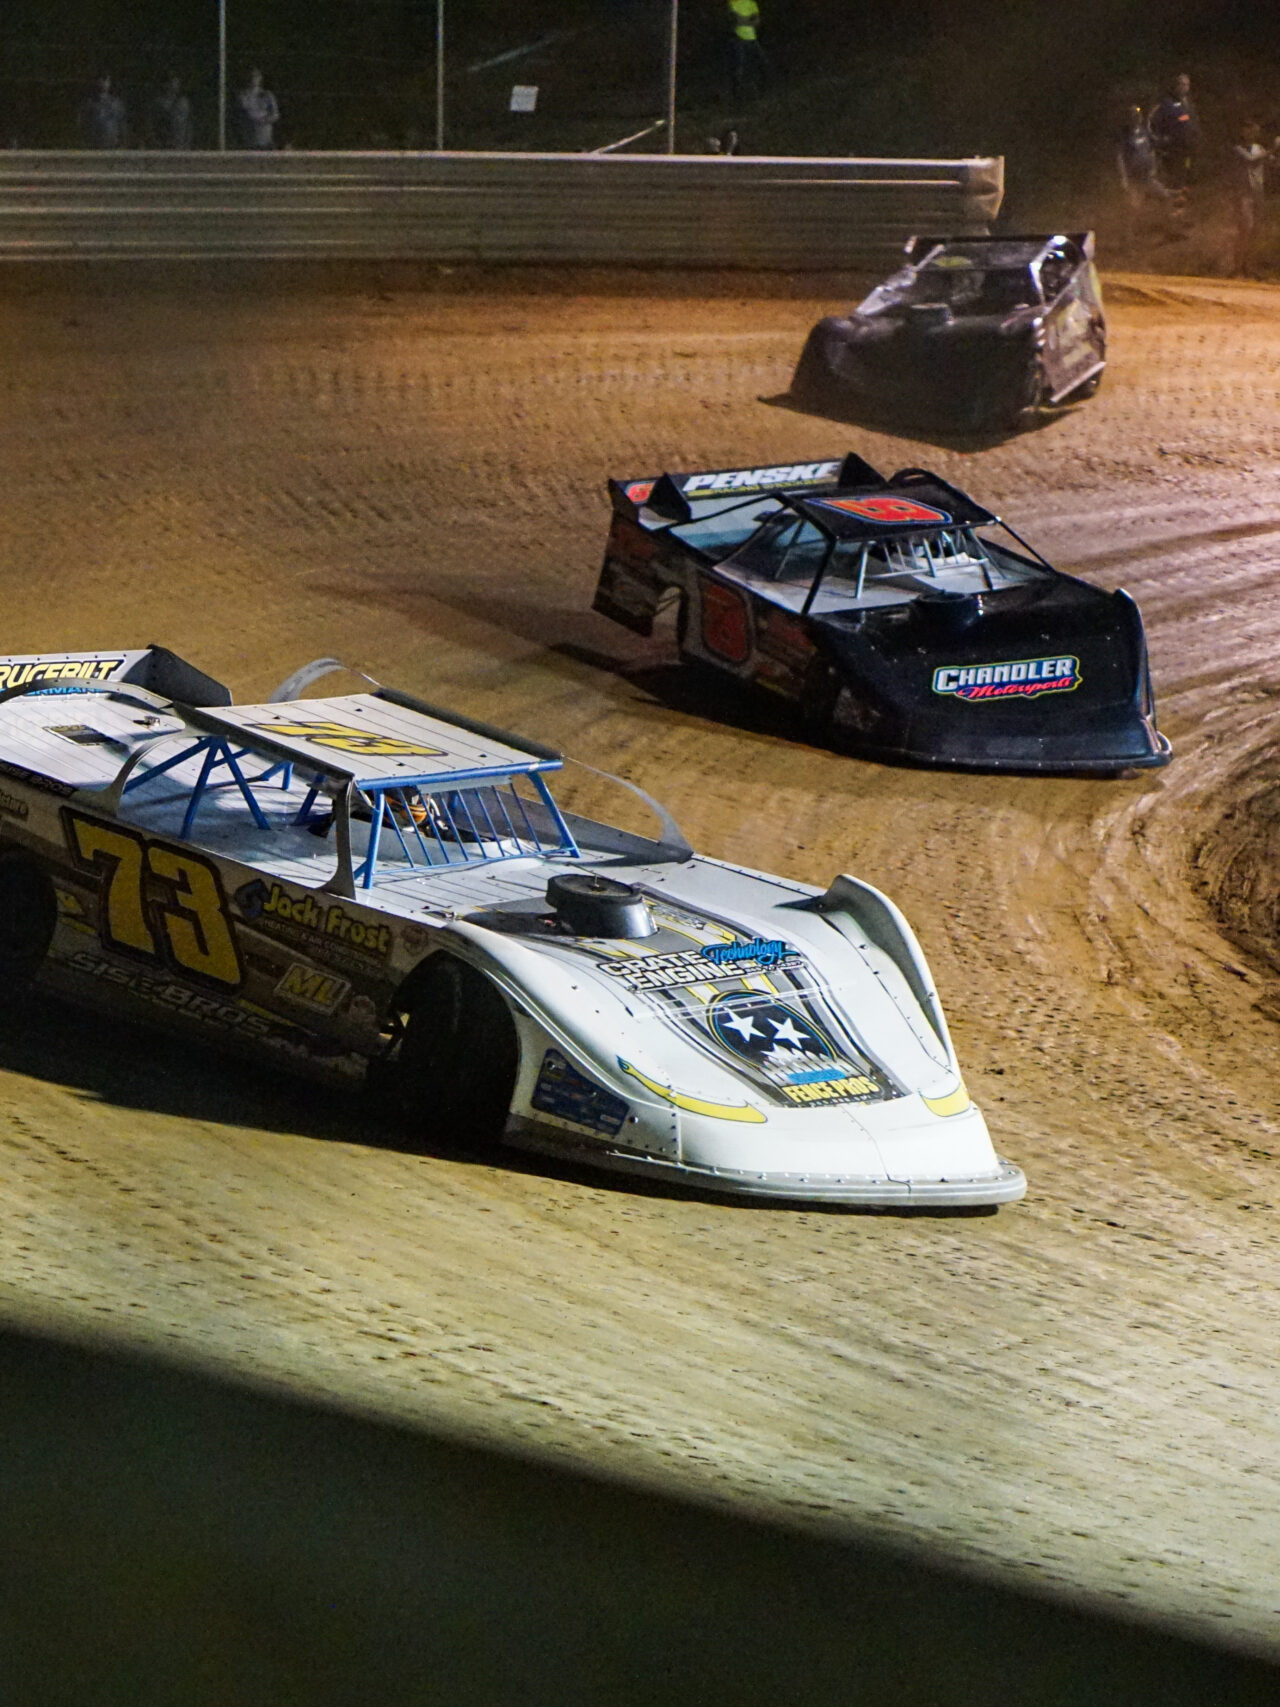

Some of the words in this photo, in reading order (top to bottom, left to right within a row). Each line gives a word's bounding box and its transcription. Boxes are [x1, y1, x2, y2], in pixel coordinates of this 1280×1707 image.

[682, 461, 841, 491] PENSKE
[936, 659, 1074, 691] CHANDLER
[243, 721, 449, 757] 73
[70, 815, 243, 986] 73
[263, 884, 322, 929] Jack
[326, 905, 390, 955] Frost
[598, 950, 710, 977] CRATE
[701, 937, 801, 965] Technology
[624, 962, 747, 989] ENGINE
[782, 1080, 840, 1103] FENCE
[833, 1075, 881, 1097] PROS
